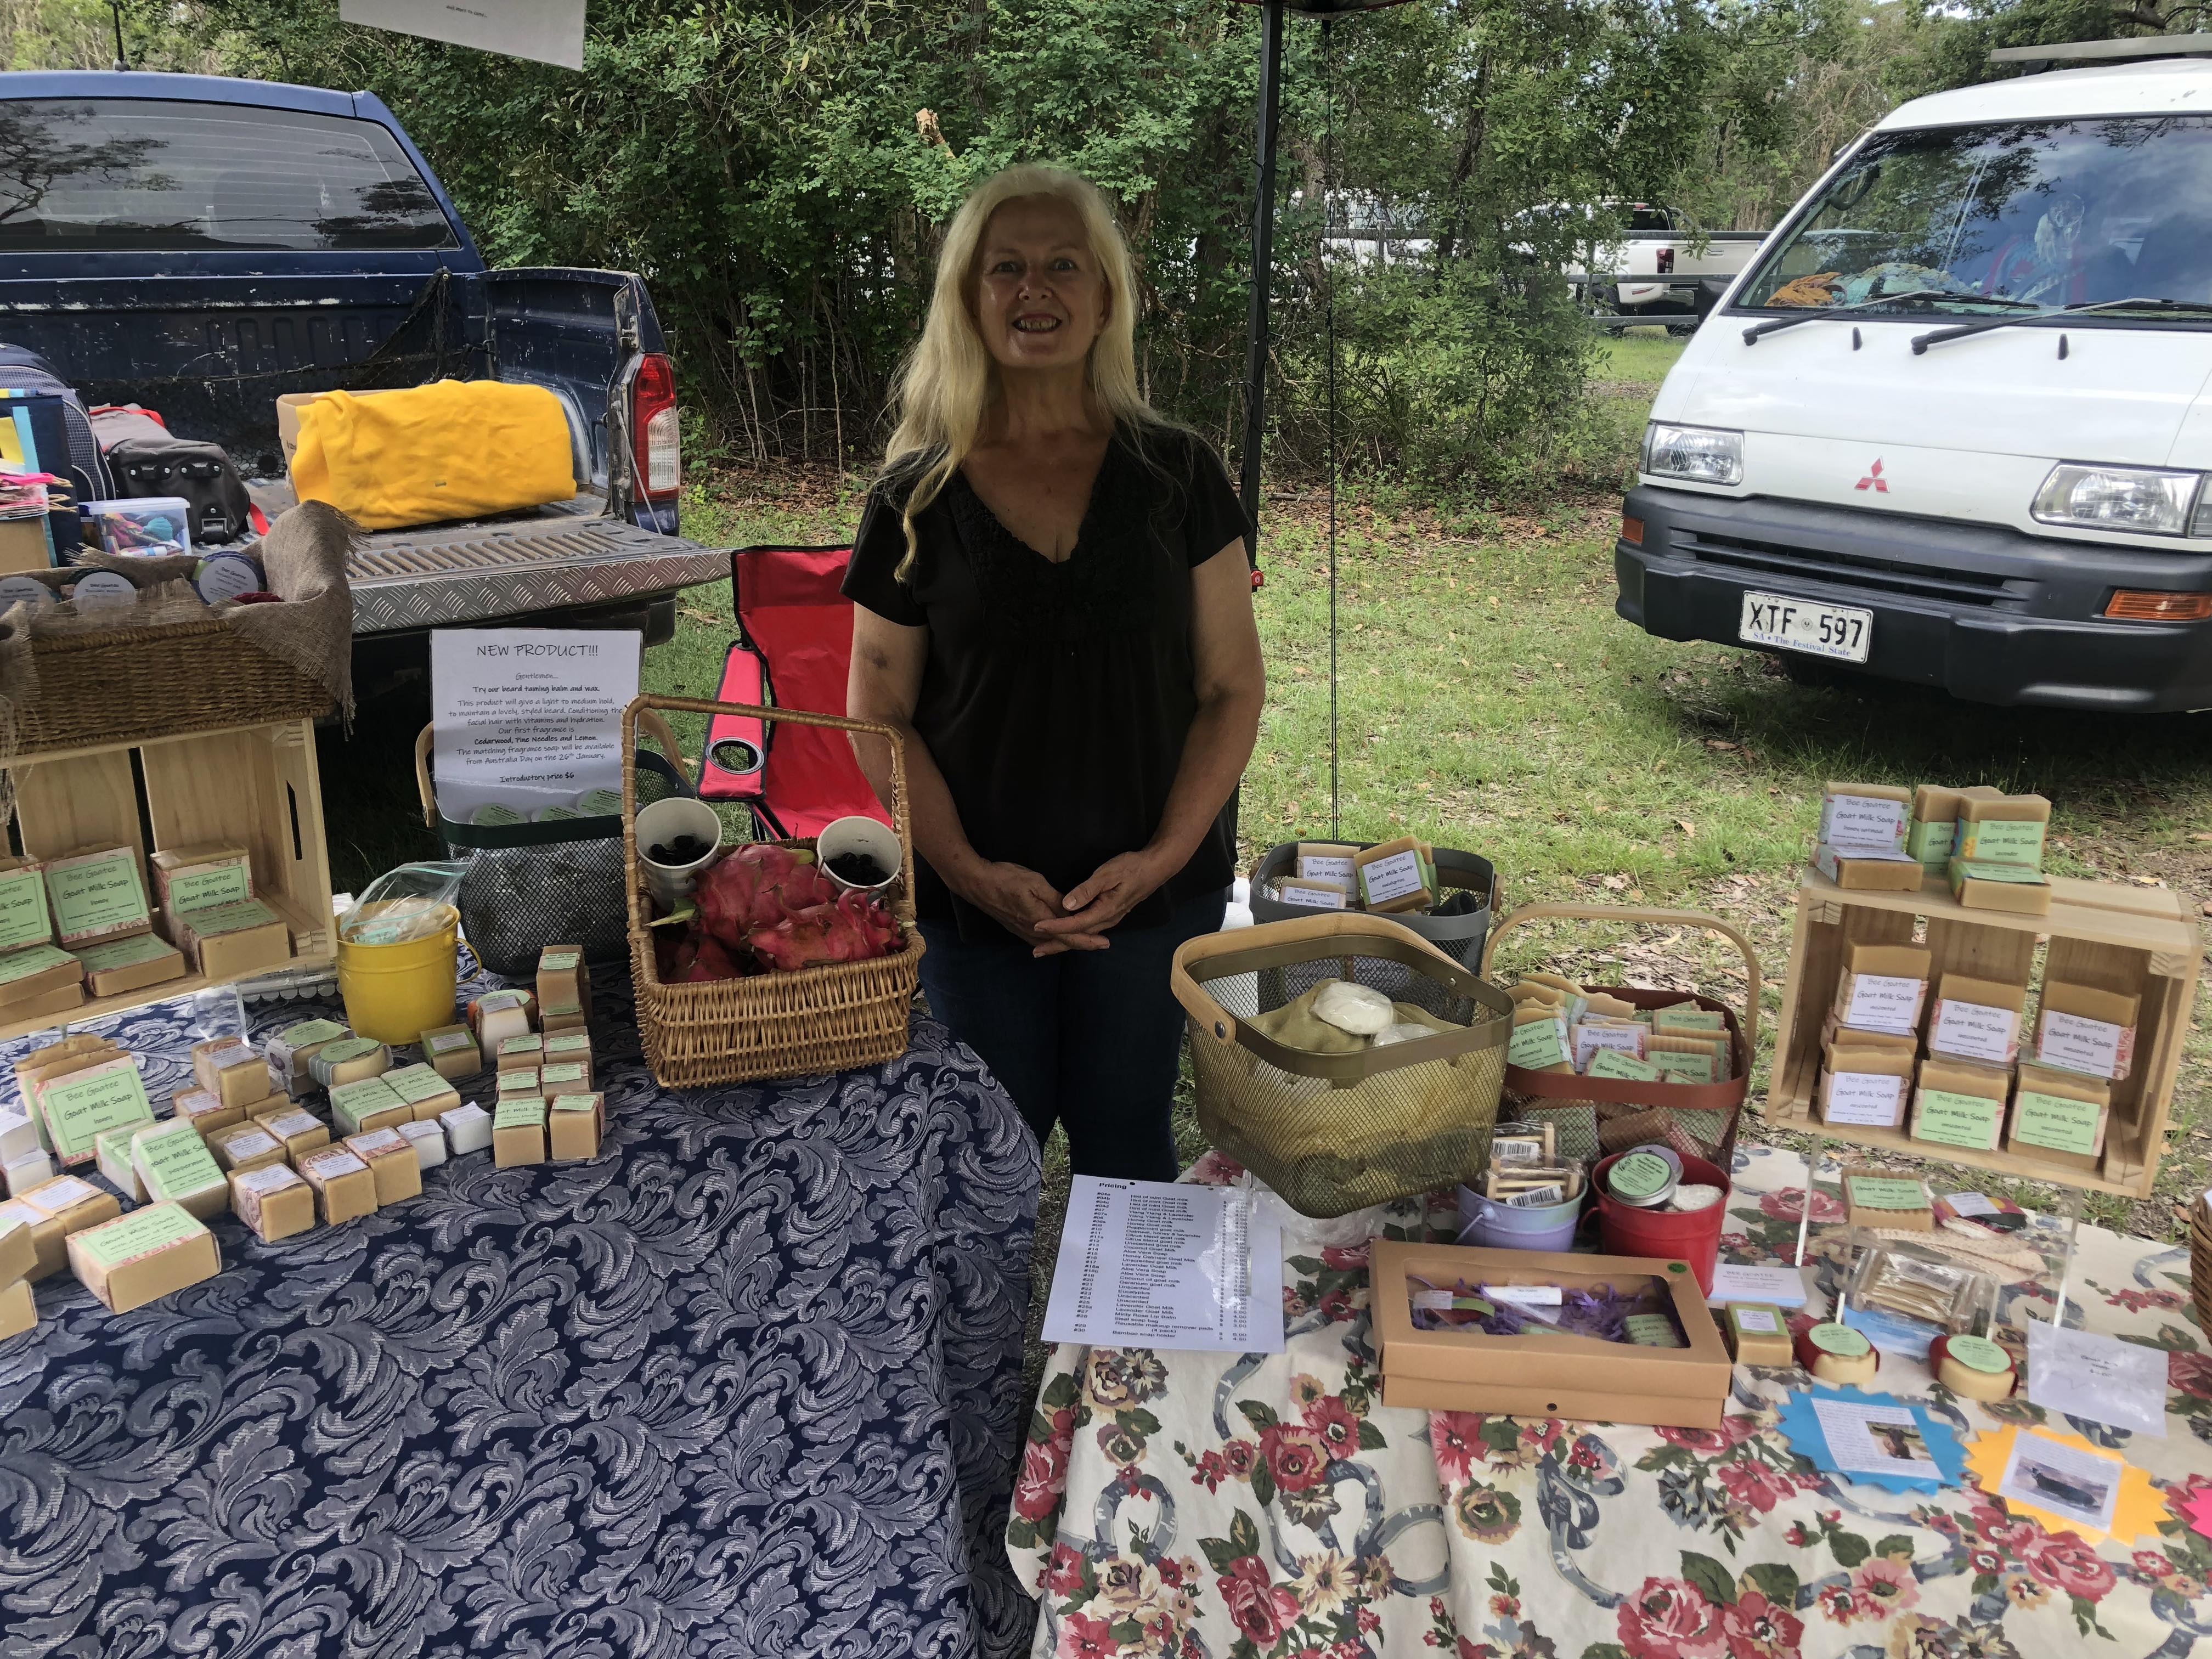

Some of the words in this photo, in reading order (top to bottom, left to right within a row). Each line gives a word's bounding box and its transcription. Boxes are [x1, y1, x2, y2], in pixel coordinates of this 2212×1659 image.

[1749, 601, 1797, 634] XTF
[1819, 614, 1863, 647] 597
[477, 645, 509, 656] NEW
[514, 644, 598, 657] PRODUCT!!!
[1753, 632, 1765, 641] SA
[1774, 635, 1790, 645] The
[1792, 639, 1825, 652] Festival
[1828, 645, 1852, 657] State
[523, 686, 550, 694] taming
[476, 698, 504, 707] product
[518, 699, 534, 707] give
[542, 697, 560, 707] light
[498, 708, 520, 716] lovely,
[521, 707, 542, 715] styled
[568, 707, 608, 716] Conditioning
[467, 718, 487, 726] facial
[570, 716, 605, 724] hydration.
[532, 726, 567, 735] fragrance
[474, 736, 514, 745] Cedarwood,
[507, 746, 542, 754] fragrance
[484, 756, 517, 765] Australia
[499, 774, 545, 783] Introductory
[546, 772, 563, 781] price
[1836, 811, 1857, 820] Goat
[1876, 815, 1895, 825] Soap
[1384, 855, 1406, 867] Goatee
[66, 873, 83, 882] Bee
[86, 866, 117, 879] Goatee
[201, 874, 231, 886] Goatee
[1368, 873, 1384, 883] Goat
[63, 888, 86, 900] Goat
[88, 883, 106, 892] Milk
[108, 879, 129, 889] Soap
[179, 894, 201, 905] Goat
[202, 889, 219, 898] Milk
[220, 887, 240, 895] Soap
[1857, 990, 1877, 998] Goat
[1895, 994, 1914, 1002] Soap
[1943, 1017, 1966, 1026] Goat
[1968, 1022, 1985, 1031] Milk
[1986, 1024, 2006, 1034] Soap
[1580, 1041, 1599, 1049] Goat
[65, 1091, 84, 1102] Bee
[86, 1081, 119, 1097] Goatee
[64, 1106, 88, 1120] Goat
[91, 1100, 110, 1110] Milk
[111, 1094, 133, 1104] Soap
[93, 1115, 114, 1125] honey
[1926, 1106, 1949, 1115] Goat
[1951, 1110, 1968, 1119] Milk
[1970, 1113, 1990, 1123] Soap
[2025, 1108, 2049, 1118] Goat
[2050, 1114, 2069, 1124] Milk
[2071, 1116, 2093, 1127] Soap
